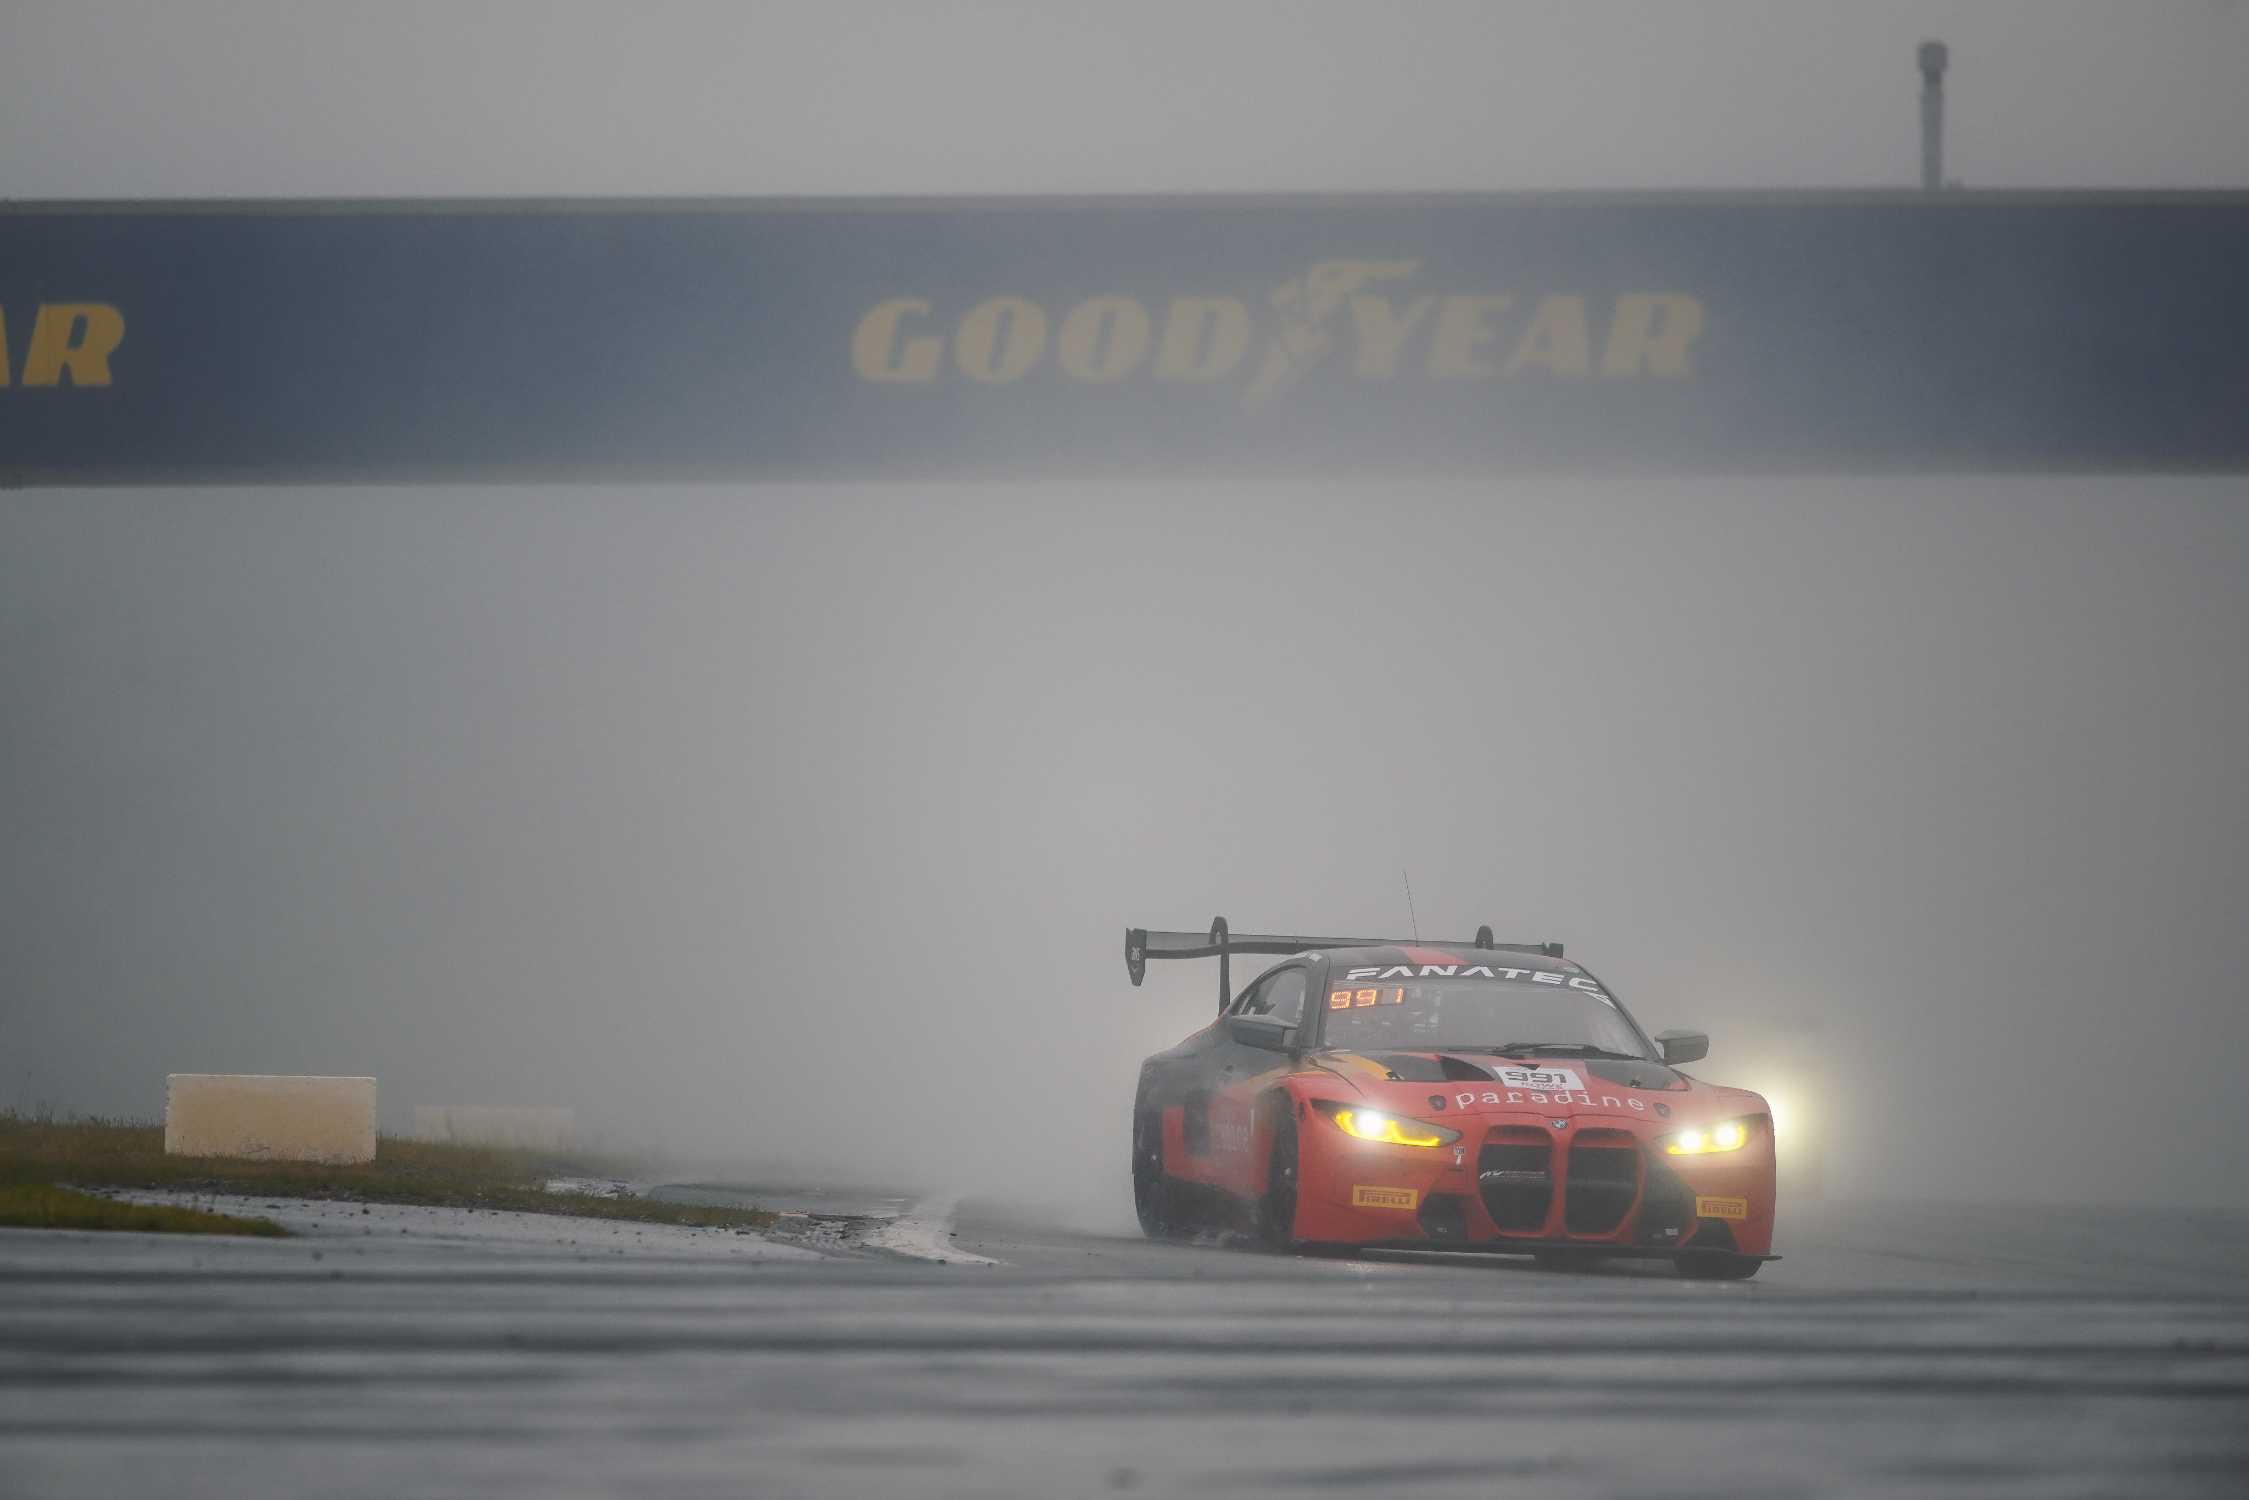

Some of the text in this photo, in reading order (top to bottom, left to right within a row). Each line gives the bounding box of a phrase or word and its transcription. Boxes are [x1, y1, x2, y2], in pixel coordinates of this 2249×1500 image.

[0, 303, 126, 387] R
[1345, 965, 1599, 991] FANATEC
[1505, 1071, 1567, 1084] 991
[1455, 1090, 1645, 1111] paradine
